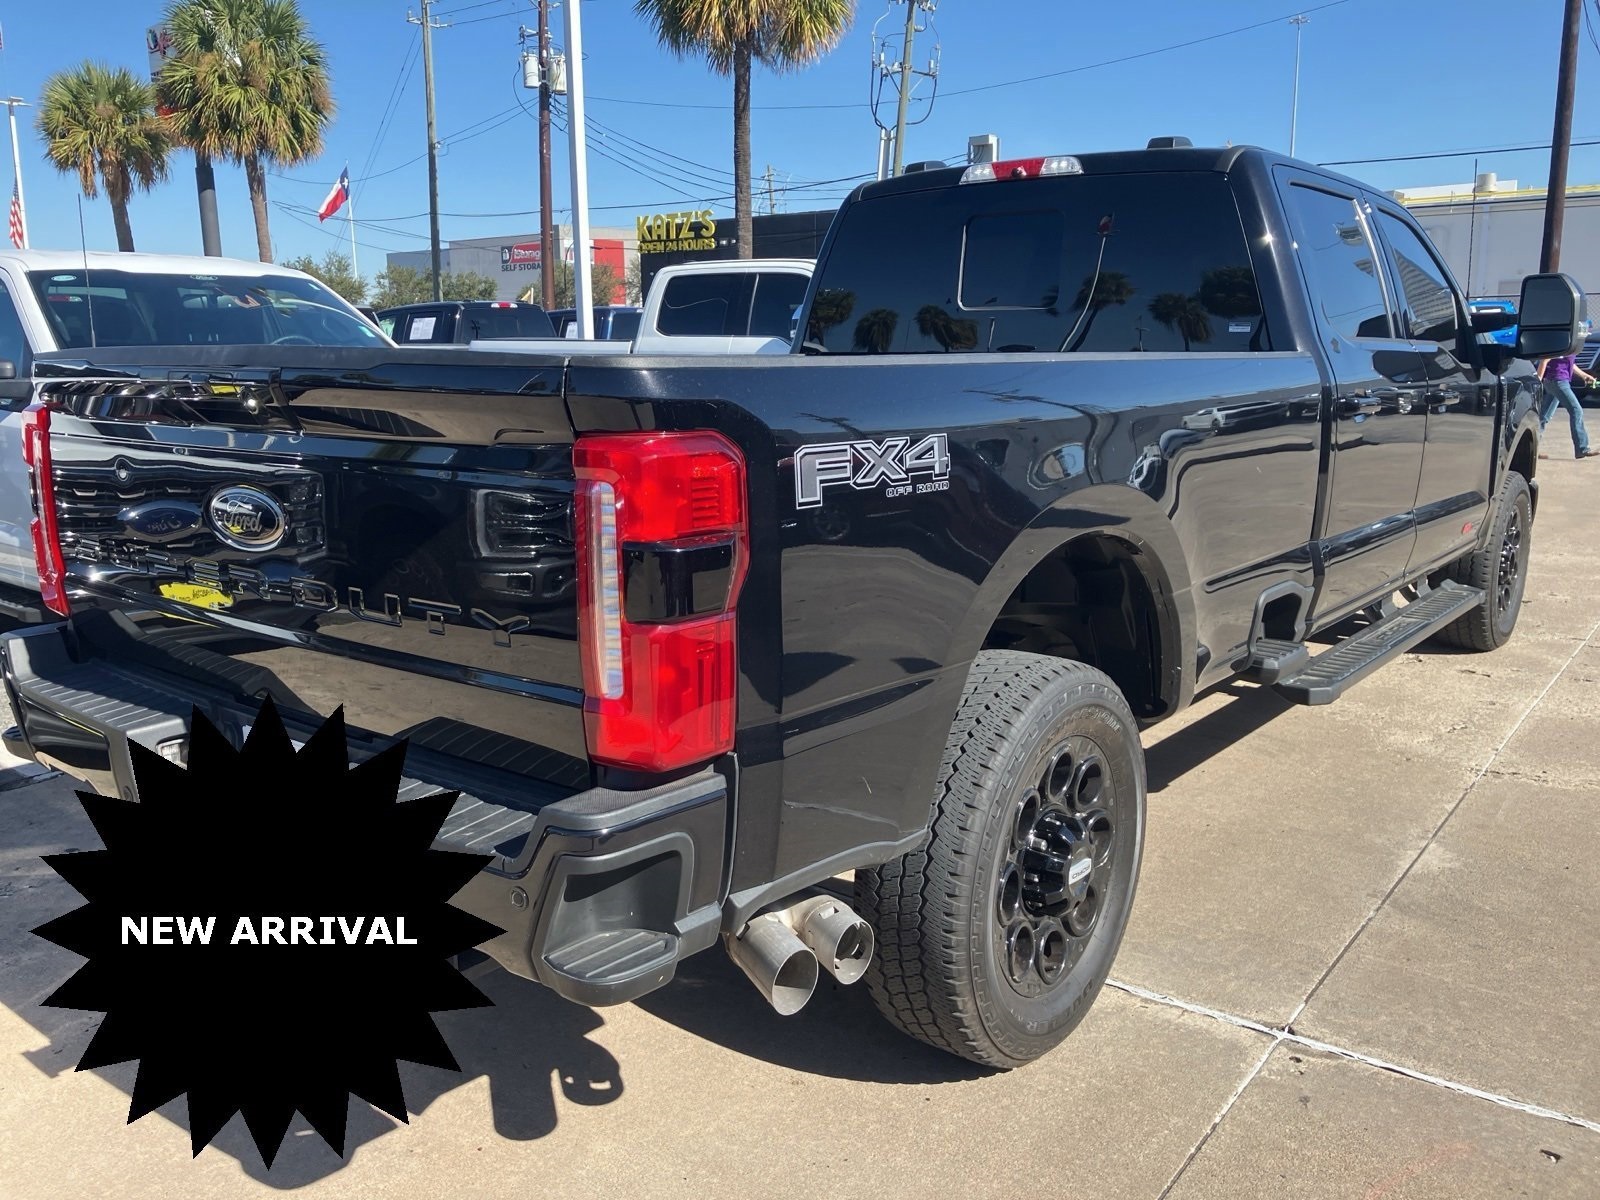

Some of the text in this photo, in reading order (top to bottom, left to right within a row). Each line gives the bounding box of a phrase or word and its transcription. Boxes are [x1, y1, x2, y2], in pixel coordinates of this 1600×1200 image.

[637, 209, 716, 241] KATZ'S
[514, 248, 541, 260] iStorag
[638, 238, 715, 254] OPEN 24 HOURS
[501, 262, 541, 272] SELF STORA
[794, 433, 951, 510] FX4
[886, 481, 949, 498] OFF ROAD
[223, 497, 262, 533] Ford
[291, 576, 531, 648] DUTY
